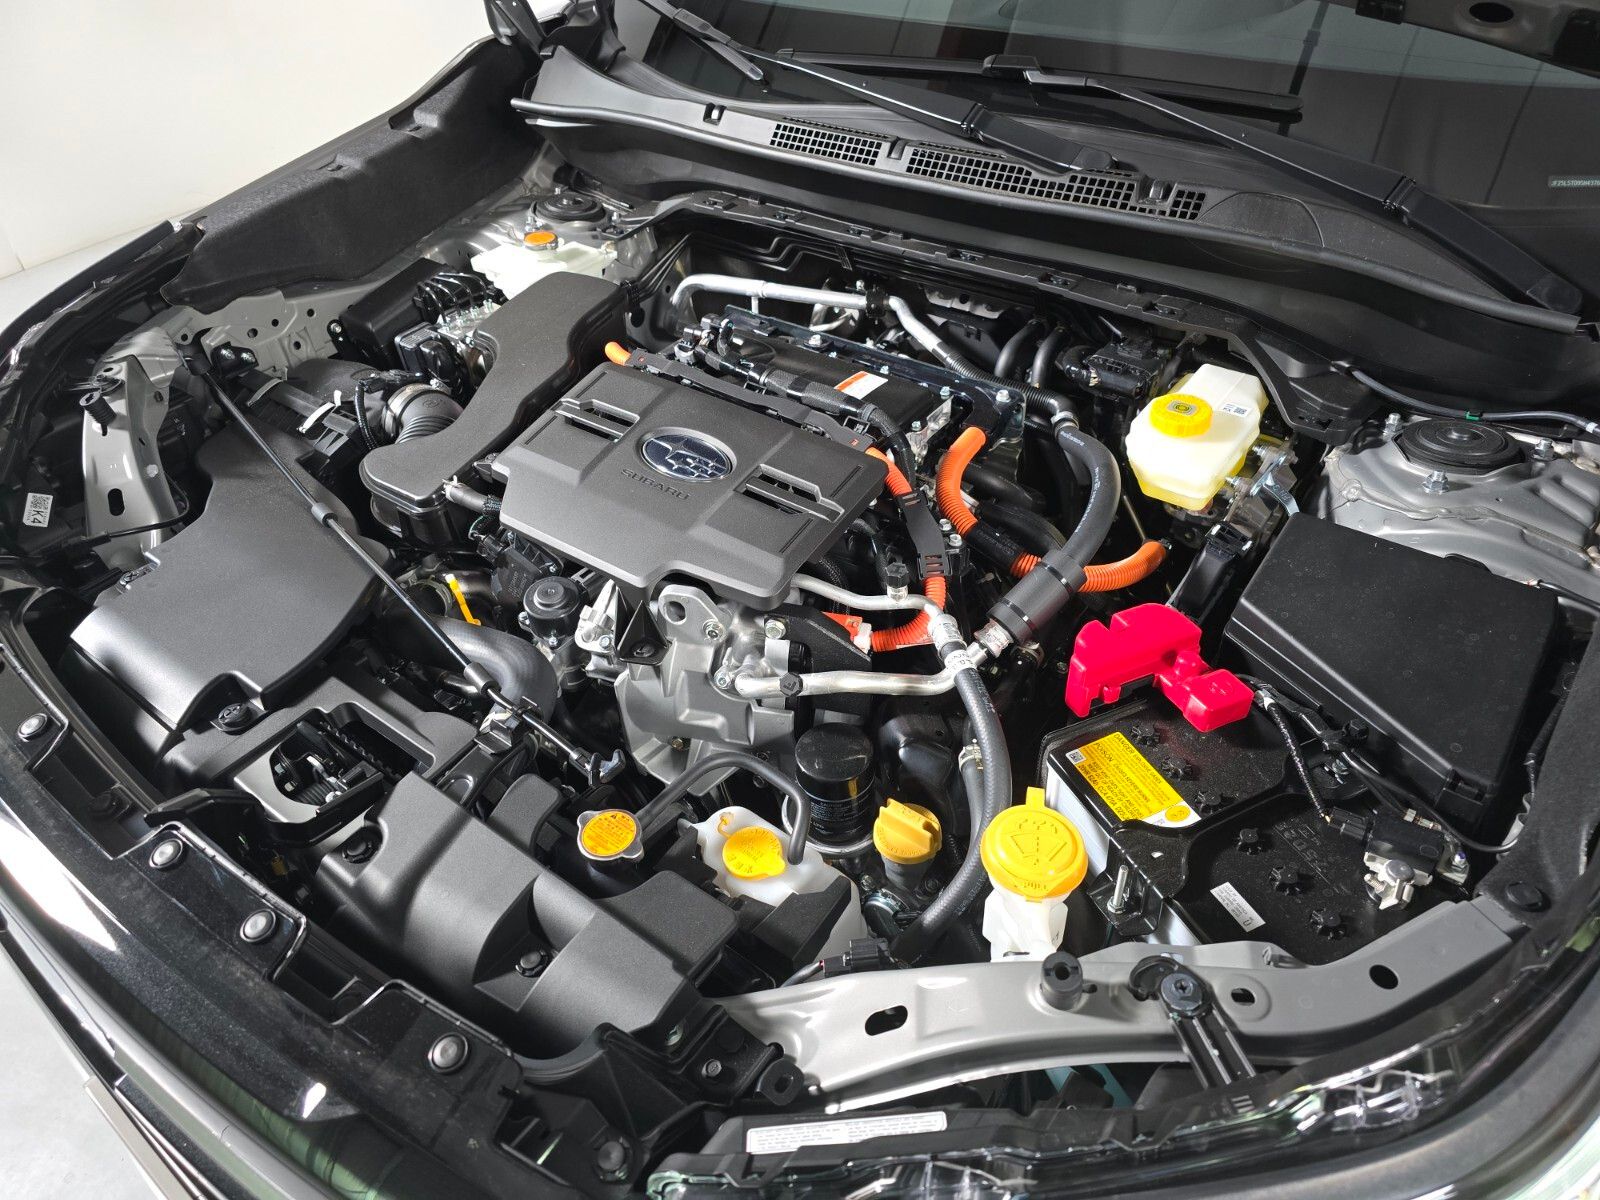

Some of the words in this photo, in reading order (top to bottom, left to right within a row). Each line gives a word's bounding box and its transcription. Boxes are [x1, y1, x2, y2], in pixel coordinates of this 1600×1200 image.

[621, 468, 690, 500] SUBARU
[1092, 742, 1114, 762] POISON
[1113, 733, 1135, 754] DANGER
